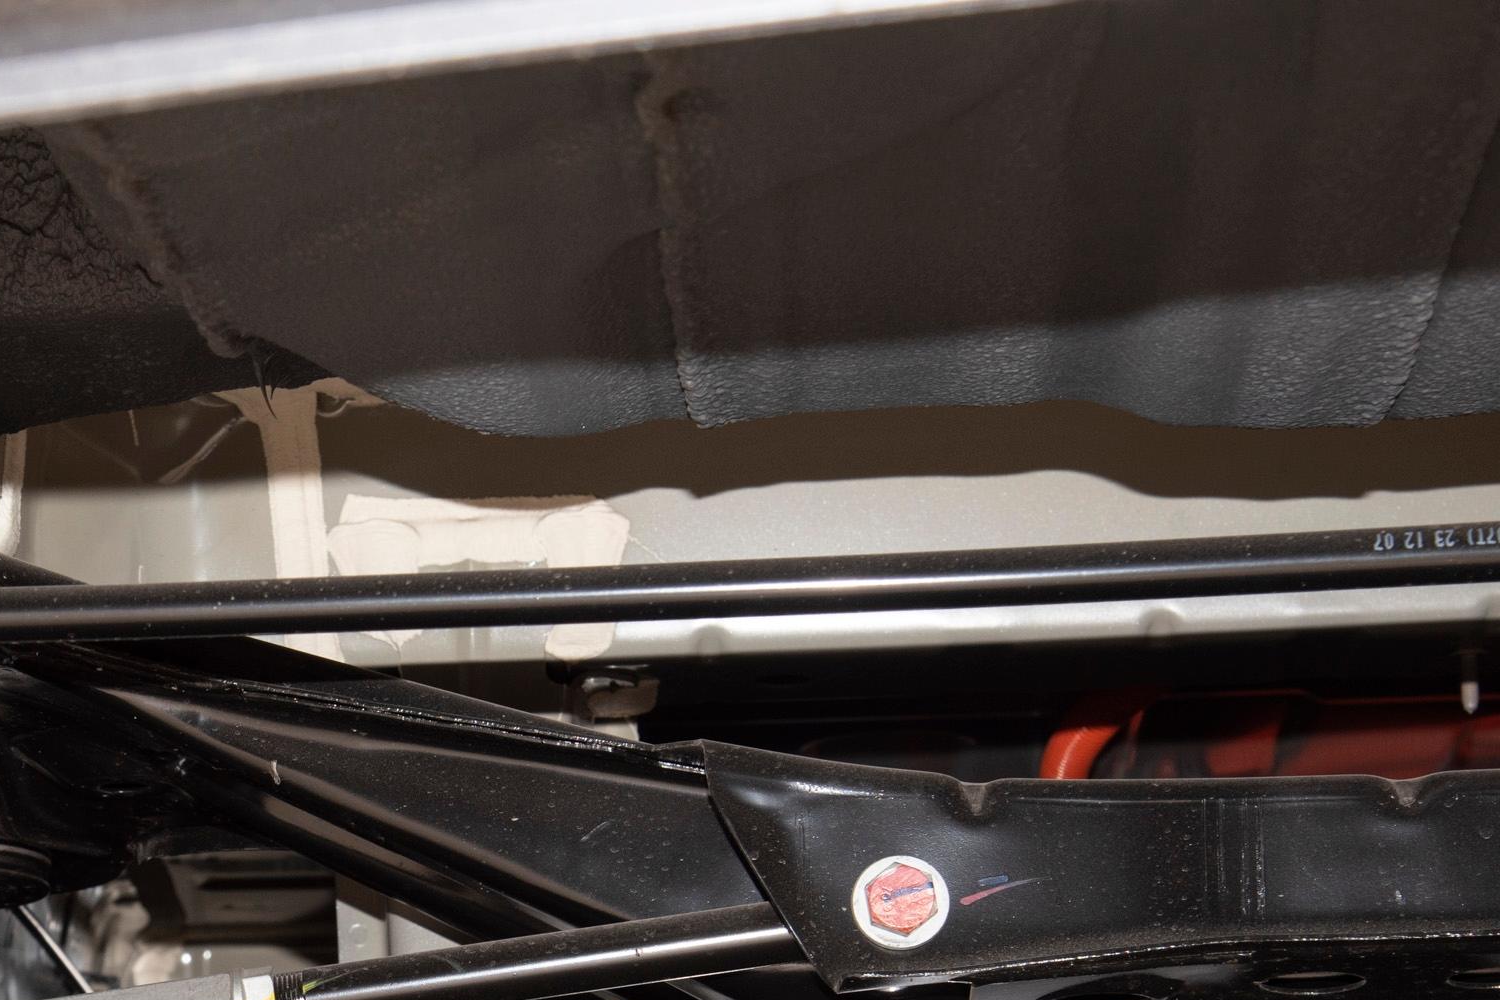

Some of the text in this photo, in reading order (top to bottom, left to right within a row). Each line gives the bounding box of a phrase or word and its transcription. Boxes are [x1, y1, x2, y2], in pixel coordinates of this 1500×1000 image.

[1373, 533, 1394, 551] 07
[1404, 531, 1423, 549] 12
[1434, 529, 1455, 547] 23
